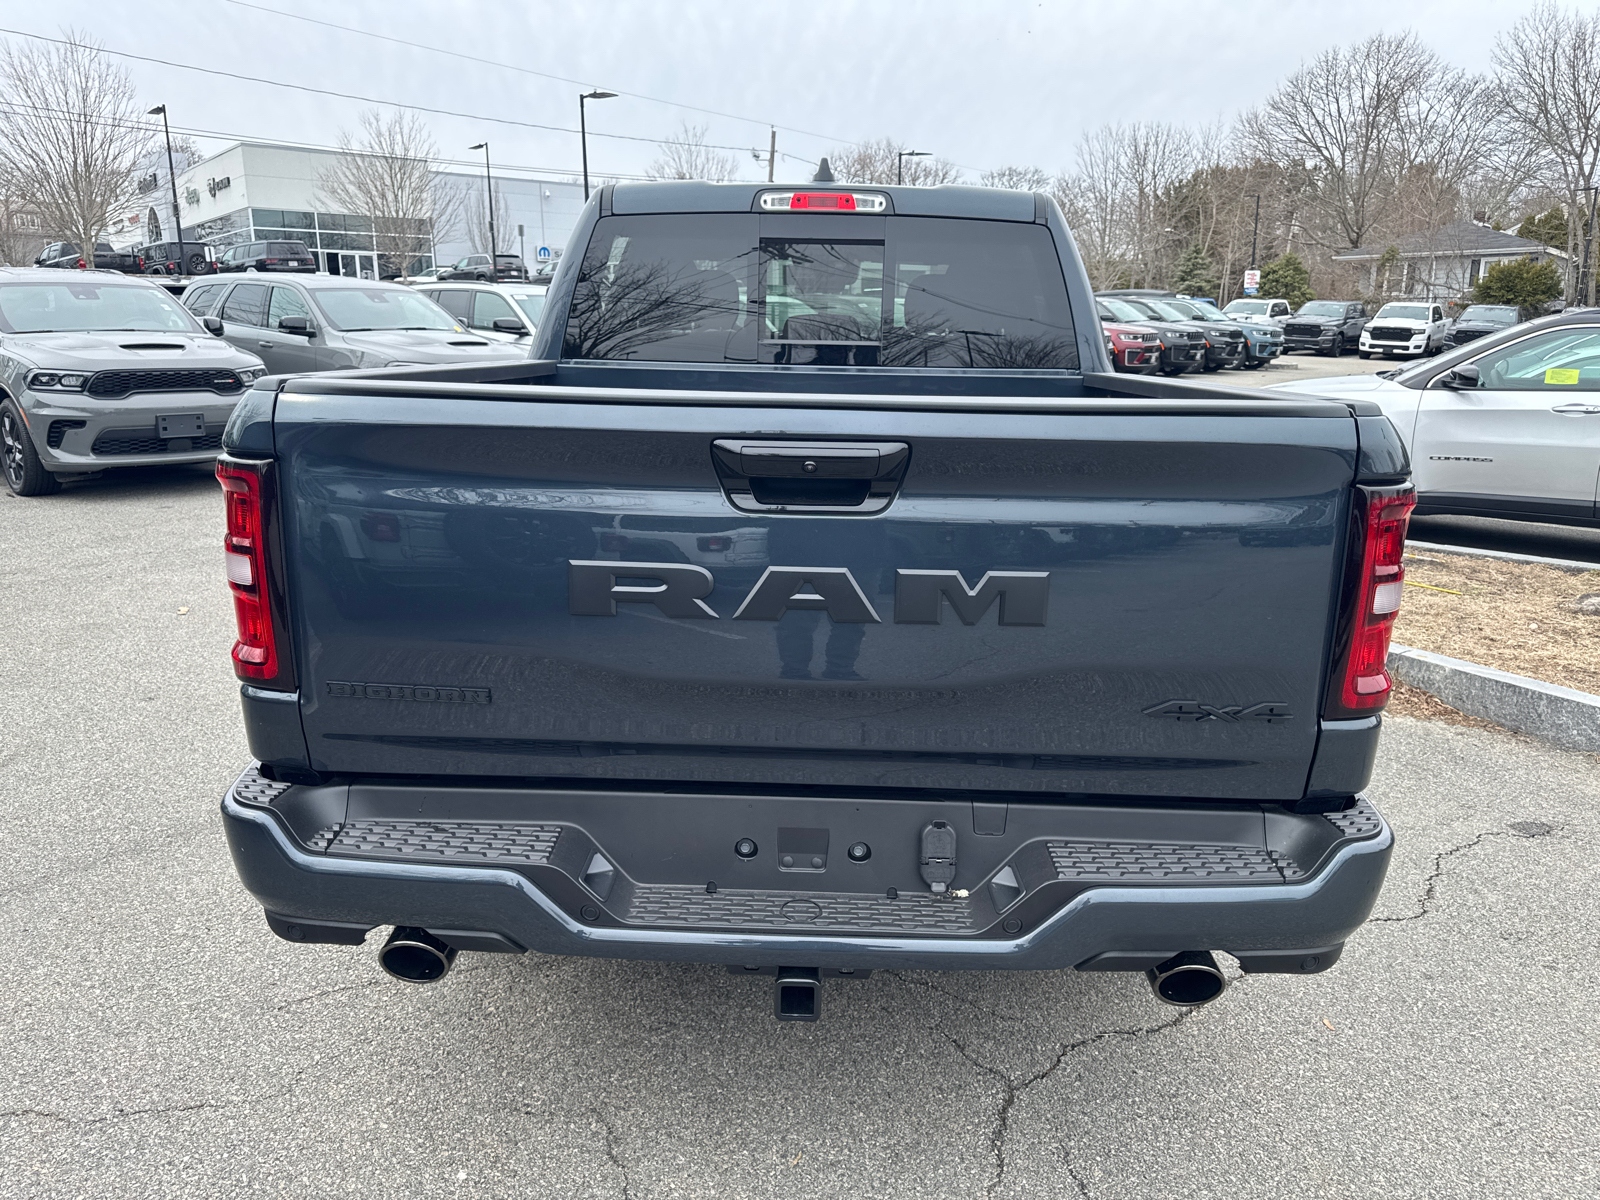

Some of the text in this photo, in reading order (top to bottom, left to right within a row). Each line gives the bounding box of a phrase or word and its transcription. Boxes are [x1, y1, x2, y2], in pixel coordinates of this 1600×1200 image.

[1429, 455, 1493, 463] COMPASS
[567, 559, 1051, 627] RAM
[326, 680, 492, 704] BIGHORN
[1141, 699, 1294, 723] 4x4
